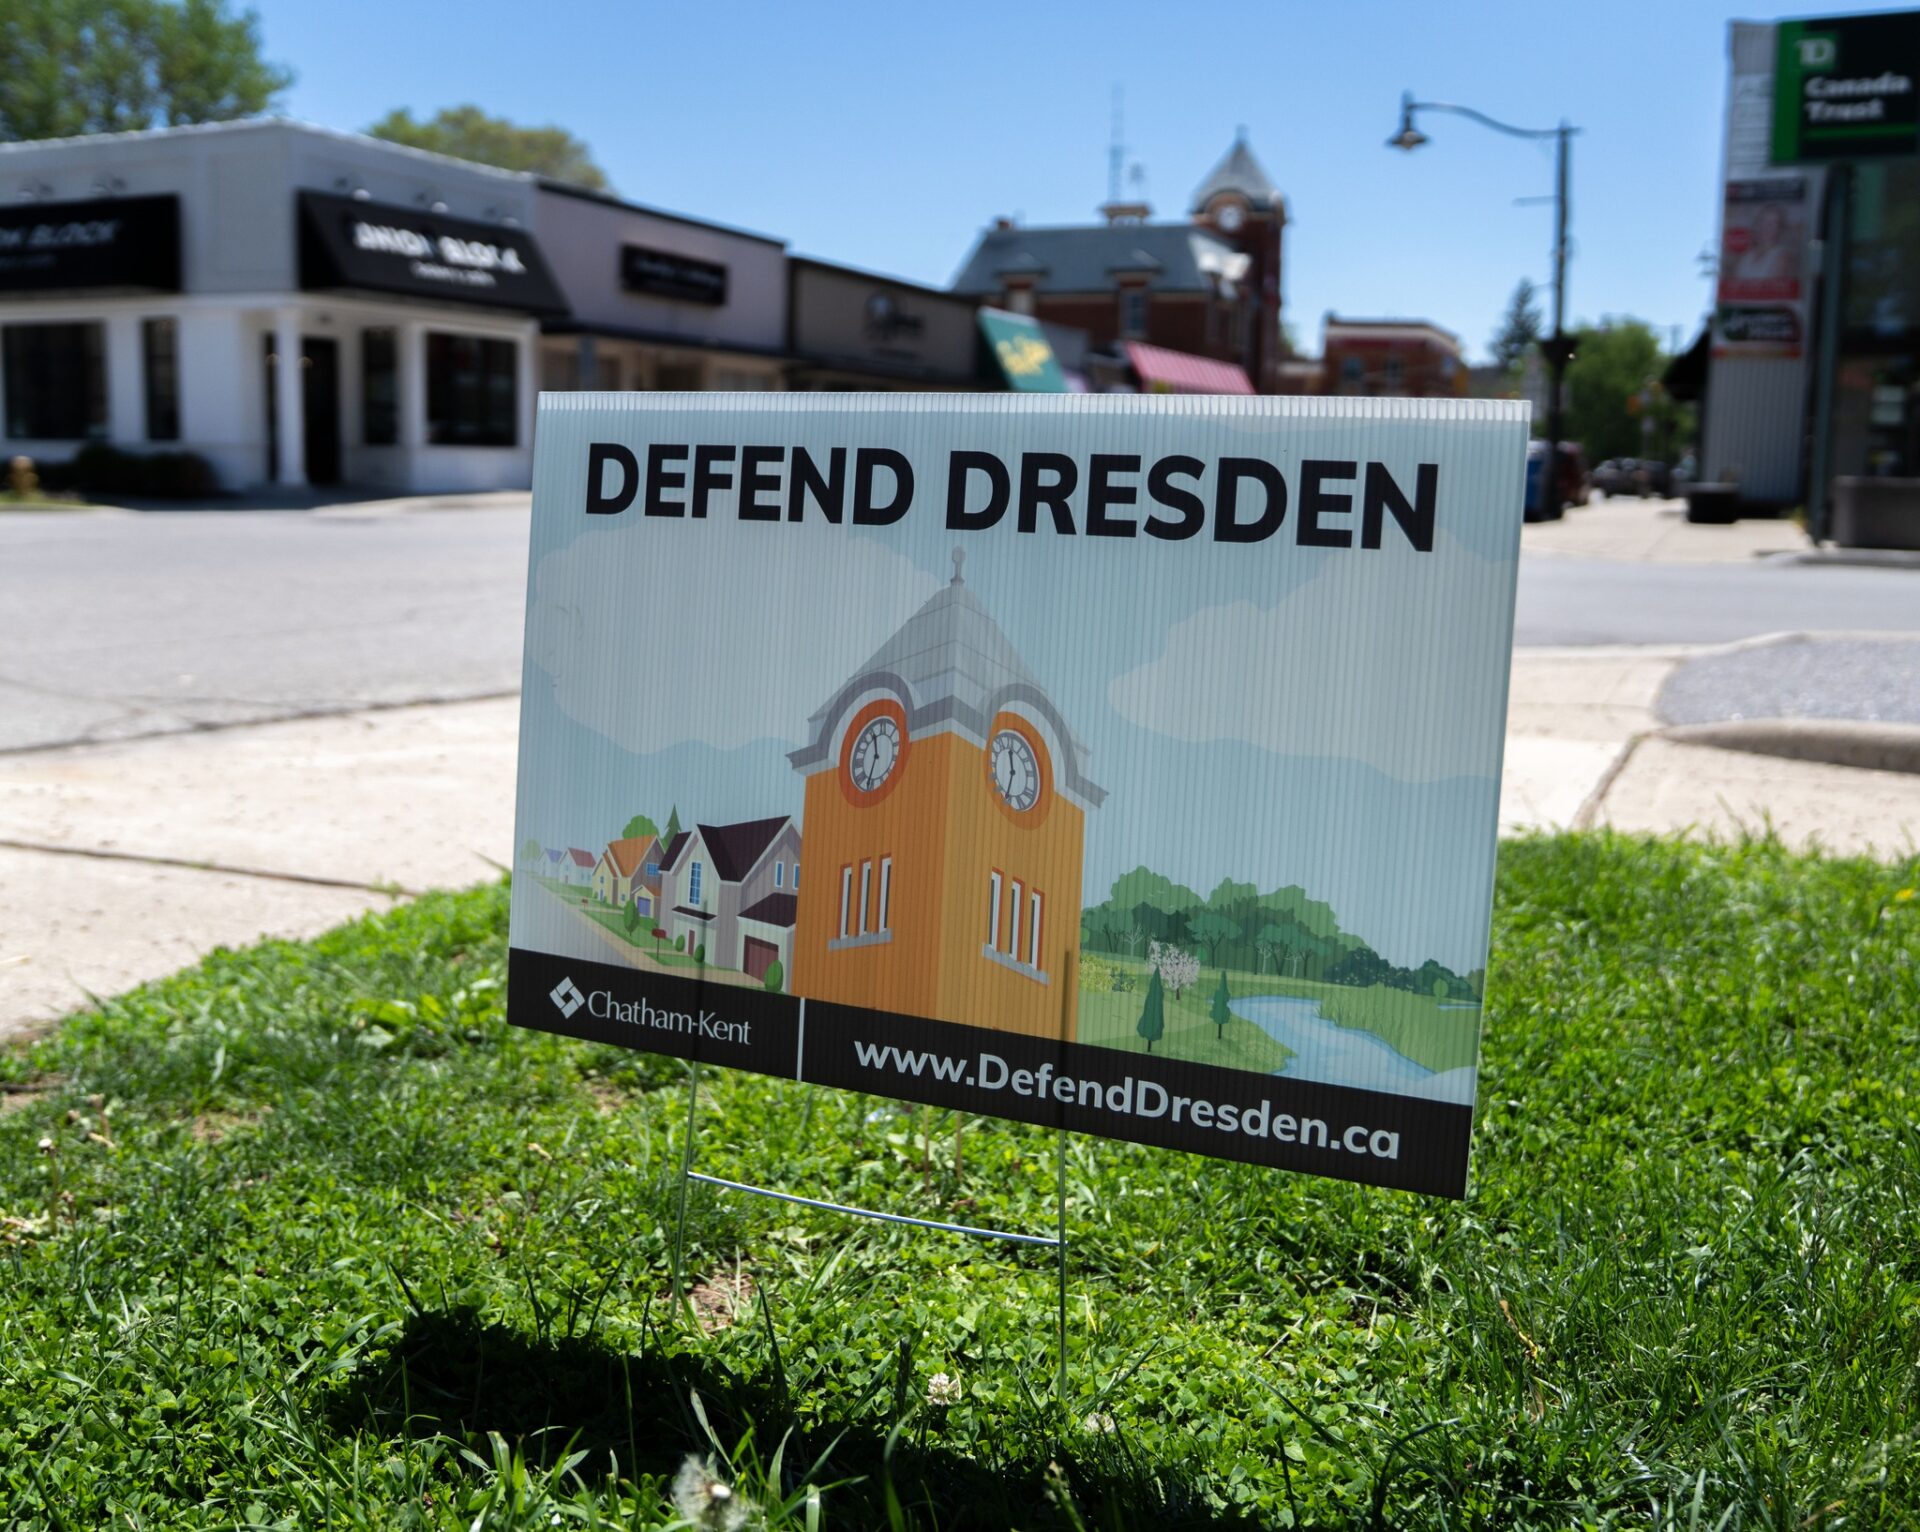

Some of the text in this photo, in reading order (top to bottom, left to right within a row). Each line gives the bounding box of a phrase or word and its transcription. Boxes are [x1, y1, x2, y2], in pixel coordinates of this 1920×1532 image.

[1805, 72, 1912, 98] Canada
[1806, 98, 1885, 122] Trust
[586, 442, 1439, 553] DEFEND DRESDEN
[588, 990, 752, 1046] Chatham-Kent
[853, 1039, 1401, 1161] www.DefendDresden.ca
